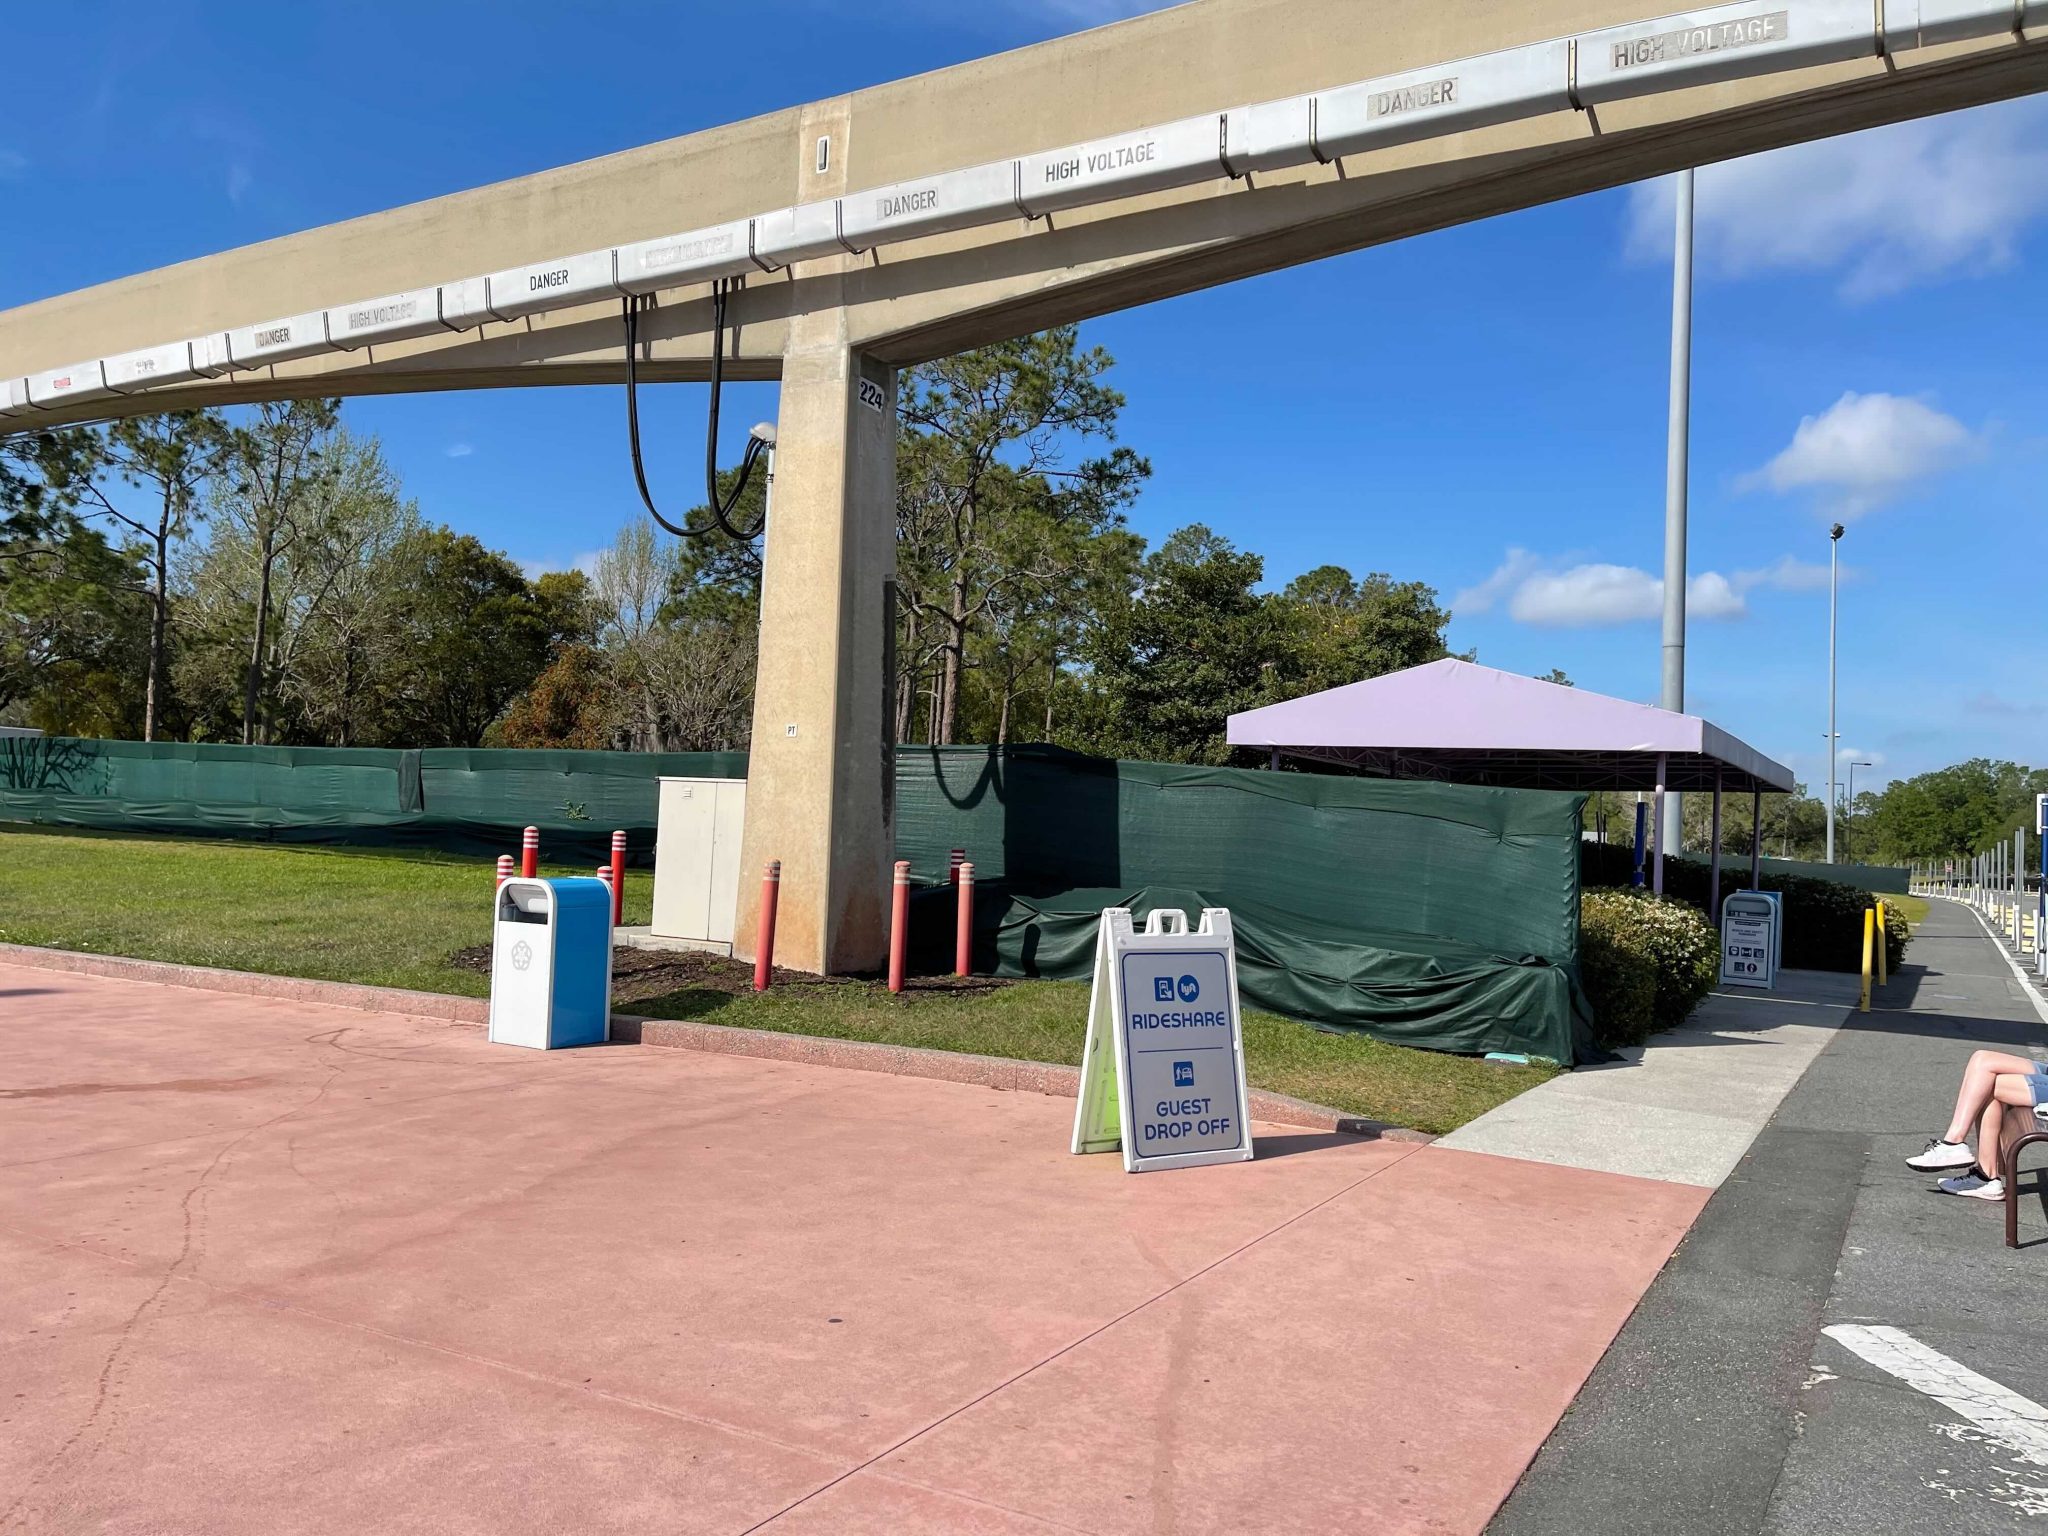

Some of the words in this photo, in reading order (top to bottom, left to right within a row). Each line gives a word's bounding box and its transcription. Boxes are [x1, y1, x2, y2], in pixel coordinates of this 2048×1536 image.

[1615, 37, 1664, 68] HIGH
[1676, 16, 1775, 54] VOLTAGE
[1377, 80, 1453, 115] DANGER
[1045, 159, 1080, 183] HIGH
[1088, 142, 1155, 174] VOLTAGE
[883, 190, 936, 217] DANGER
[530, 269, 569, 291] DANGER
[350, 312, 371, 329] HIGH
[259, 328, 290, 347] DANGER
[860, 381, 882, 409] 224
[1132, 1011, 1226, 1030] RIDESHARE
[1156, 1098, 1211, 1117] GUEST
[1145, 1121, 1192, 1140] DROP
[1198, 1118, 1230, 1136] OFF
